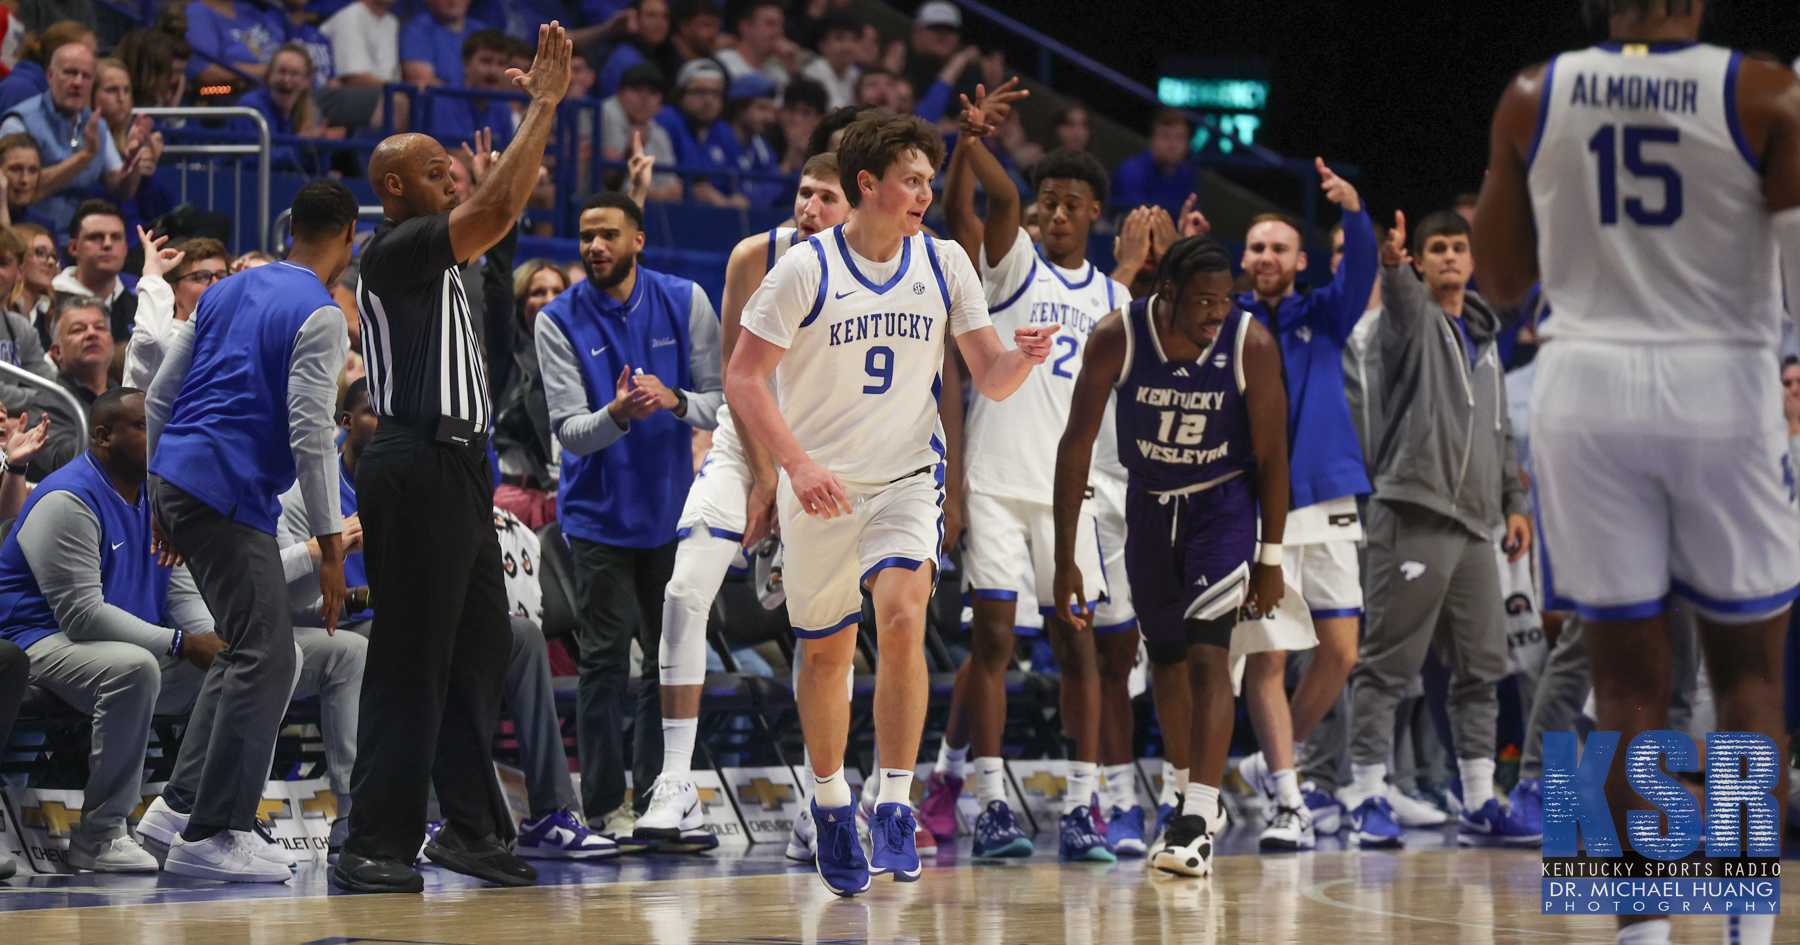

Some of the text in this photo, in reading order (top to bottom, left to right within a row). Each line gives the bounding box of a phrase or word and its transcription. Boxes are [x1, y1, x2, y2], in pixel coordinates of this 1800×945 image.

[1571, 72, 1698, 114] ALMONOR
[1588, 121, 1684, 228] 15
[829, 312, 934, 347] KENTUCKY
[862, 346, 895, 395] 9
[1136, 385, 1226, 411] KENTUCKY
[1157, 411, 1208, 446] 12
[1136, 438, 1230, 465] WESLEYAN
